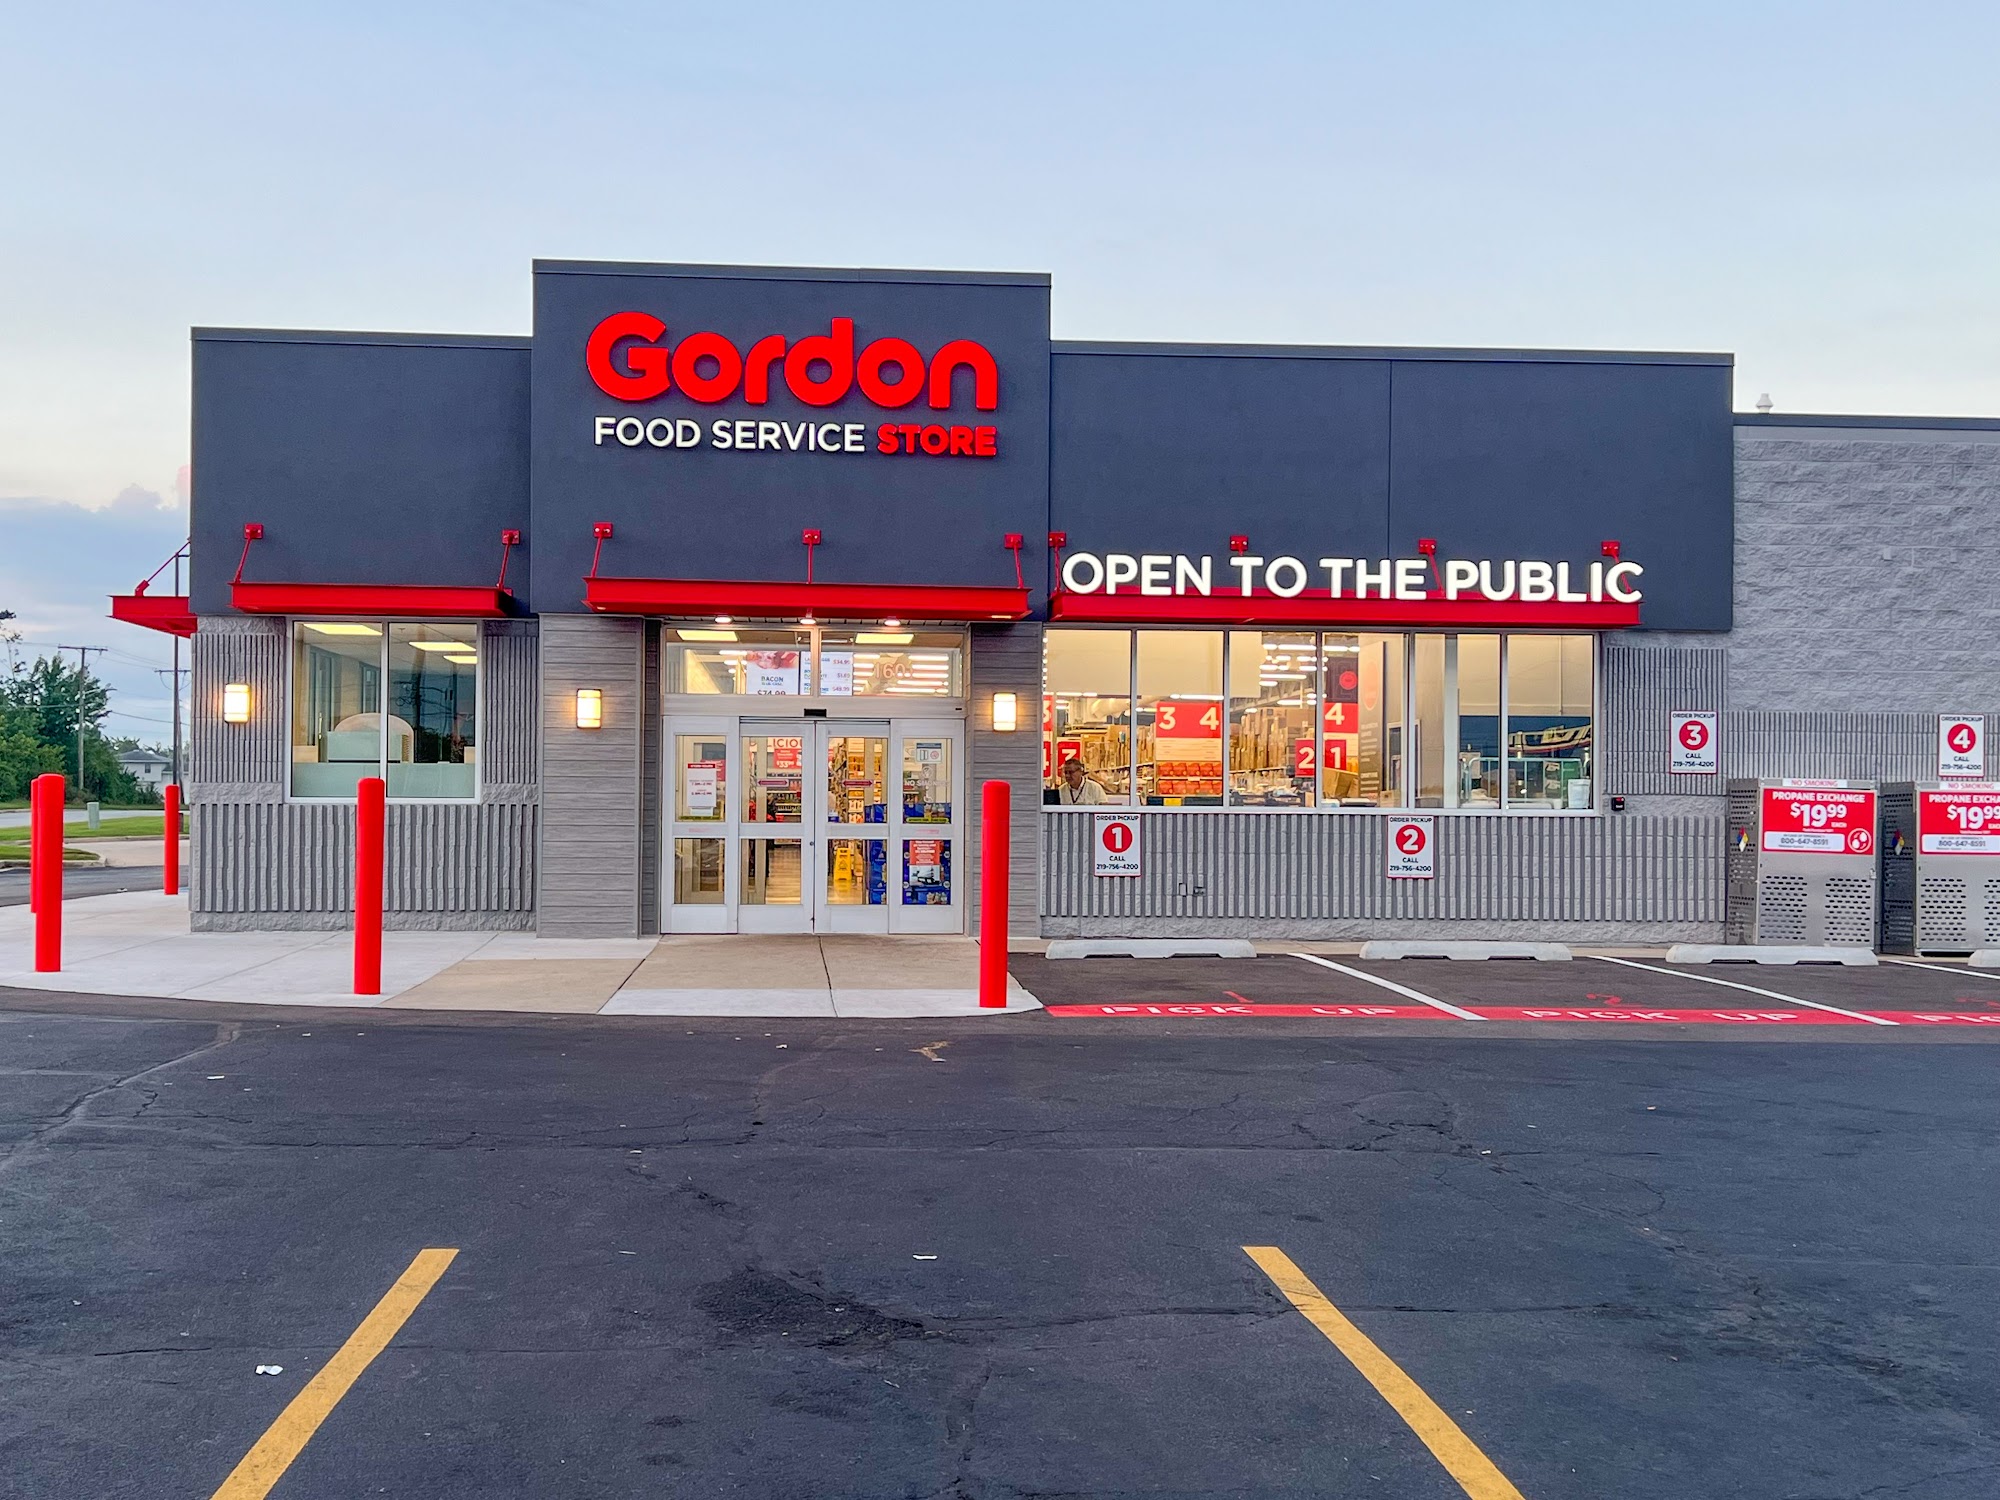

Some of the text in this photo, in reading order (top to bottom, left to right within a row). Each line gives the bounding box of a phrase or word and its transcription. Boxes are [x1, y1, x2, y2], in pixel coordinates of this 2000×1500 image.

[586, 311, 998, 410] Gordon
[594, 416, 997, 456] FOOD SERVICE STORE
[1062, 553, 1645, 603] OPEN TO THE PUBLIC
[1158, 706, 1220, 731] 3 4
[1324, 702, 1345, 726] 4
[1686, 724, 1702, 746] 3
[1952, 728, 1971, 749] 4
[1298, 746, 1315, 769] 2
[1330, 747, 1341, 769] 1
[1772, 791, 1866, 804] PROPANE EXCHANGE
[1928, 794, 1972, 803] PROPANE
[1111, 826, 1123, 849] 1
[1402, 828, 1419, 851] 2
[1780, 837, 1829, 846] 800-647-8591
[1101, 1006, 1397, 1015] PICK UP
[1521, 1010, 1798, 1021] PICK UP
